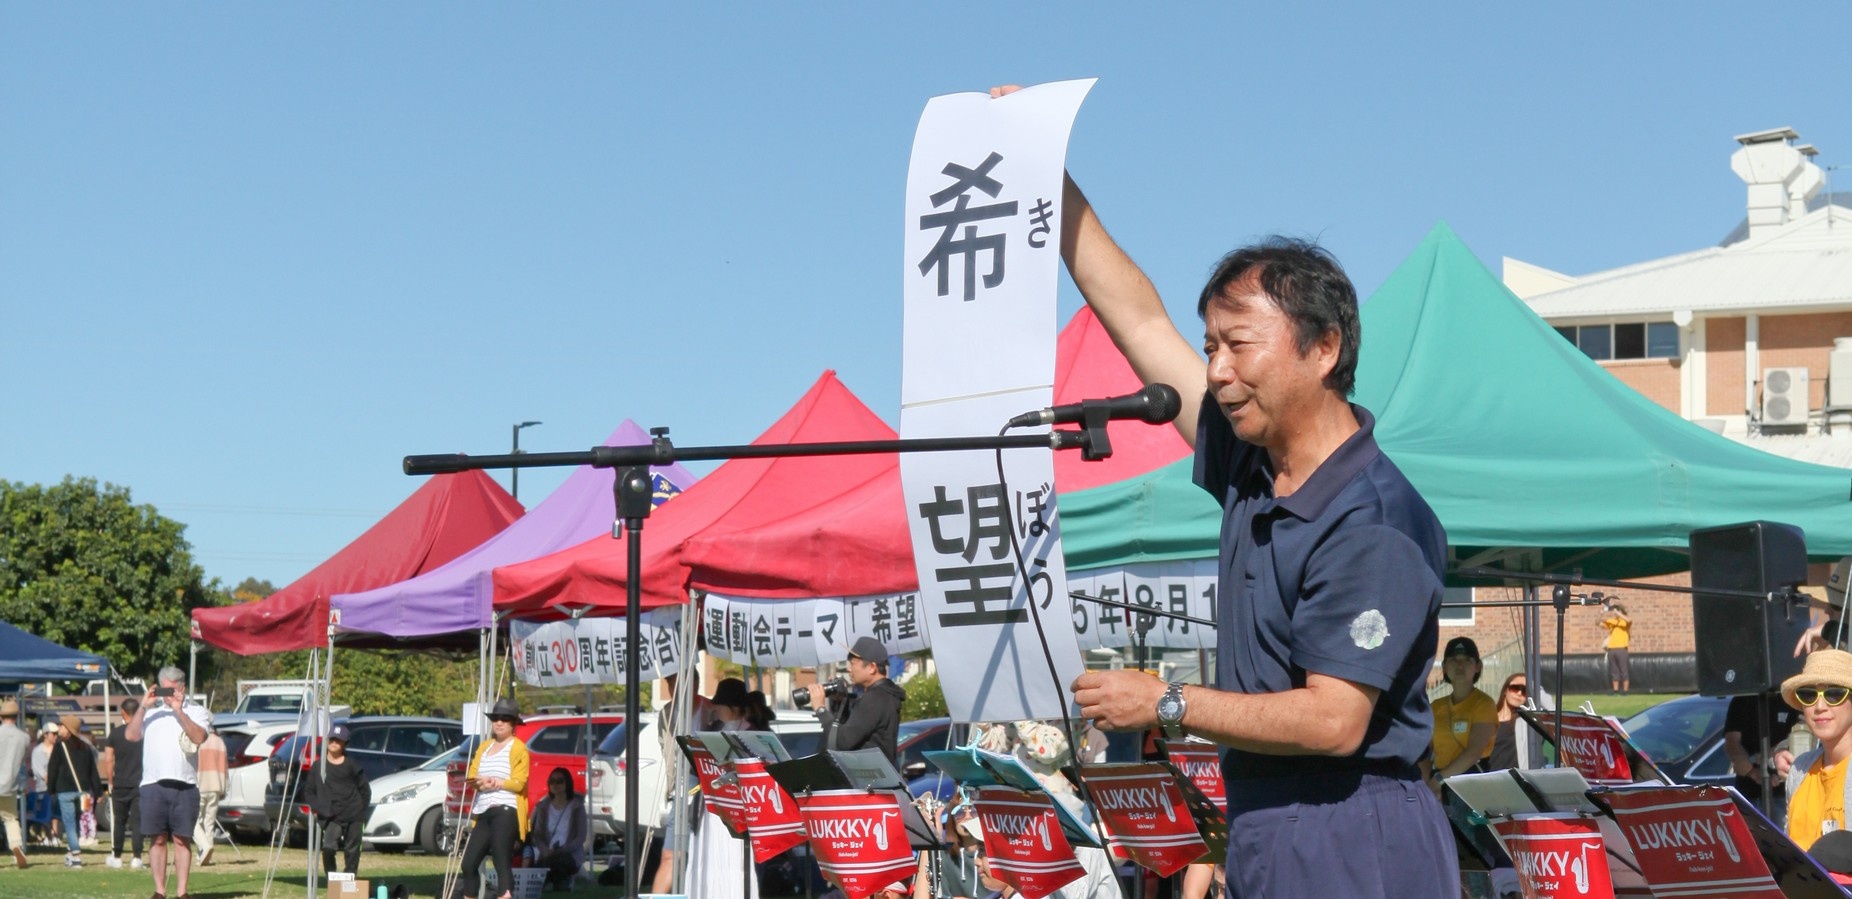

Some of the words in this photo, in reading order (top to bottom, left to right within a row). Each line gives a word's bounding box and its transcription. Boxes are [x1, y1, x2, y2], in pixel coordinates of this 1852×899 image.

[918, 151, 1018, 301] 希
[1028, 198, 1053, 248] き
[919, 483, 1028, 627] 望
[1016, 482, 1053, 610] ぼう
[1096, 787, 1159, 810] LUKKKY
[809, 818, 872, 839] LUKKKY
[983, 813, 1037, 836] LUKKKY
[1629, 819, 1716, 850] LUKKKY
